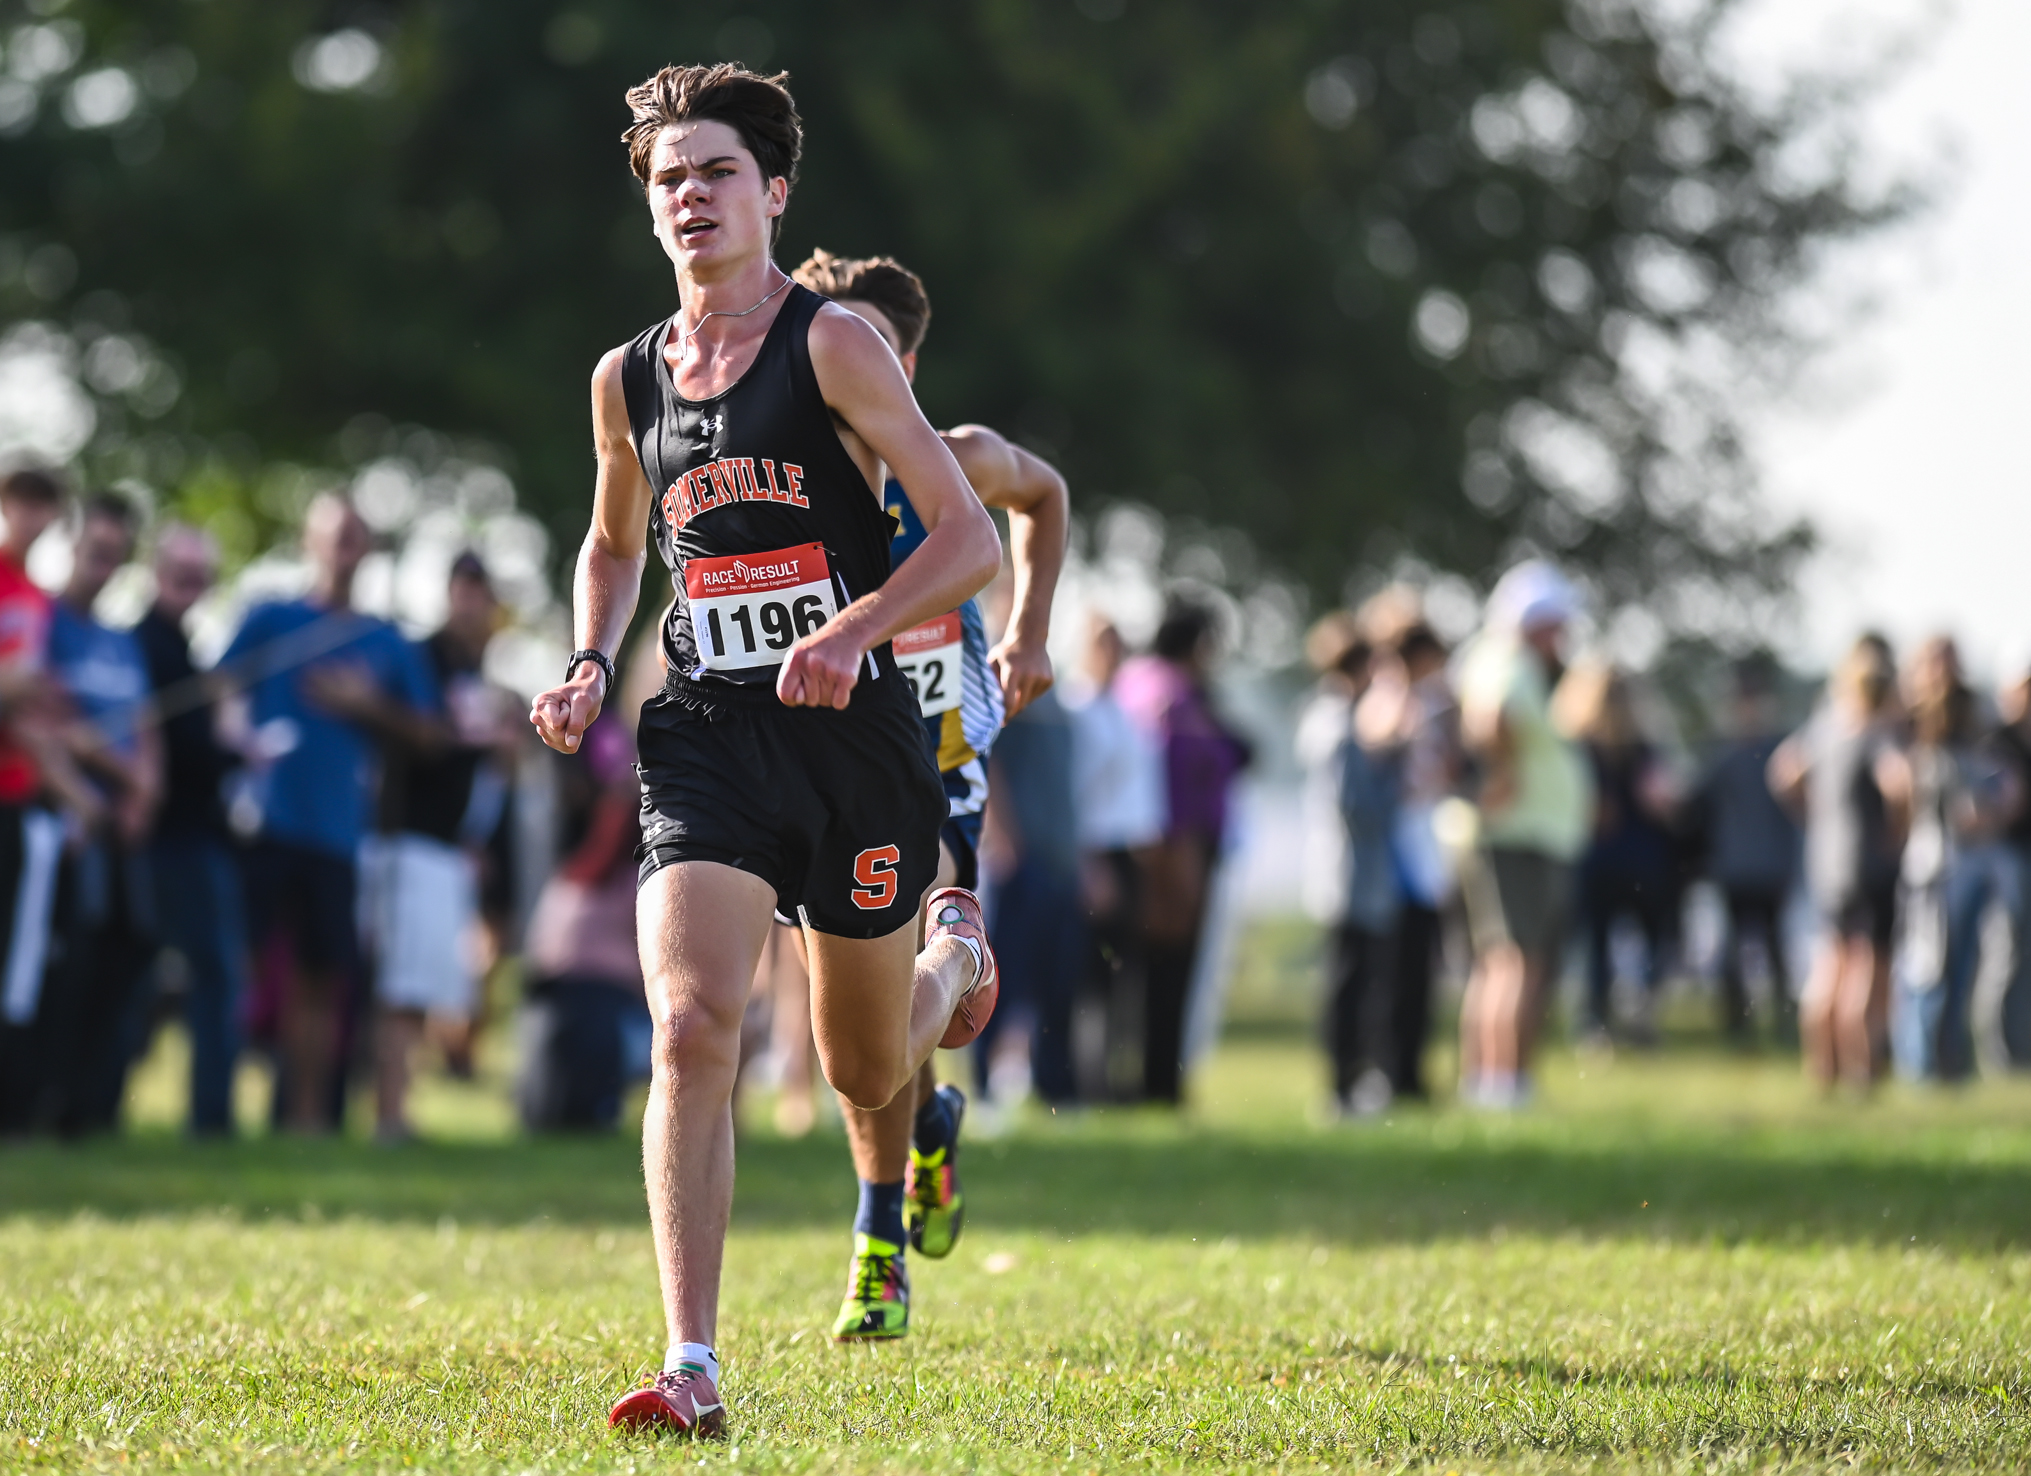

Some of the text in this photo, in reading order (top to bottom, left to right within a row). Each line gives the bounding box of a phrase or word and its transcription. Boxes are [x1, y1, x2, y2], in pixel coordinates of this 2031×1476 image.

[661, 457, 810, 542] SOMERVILLE
[703, 560, 799, 586] RACE RESULT
[750, 581, 769, 589] German
[769, 576, 800, 587] Engineering
[707, 594, 828, 656] 1196
[851, 844, 900, 910] S
